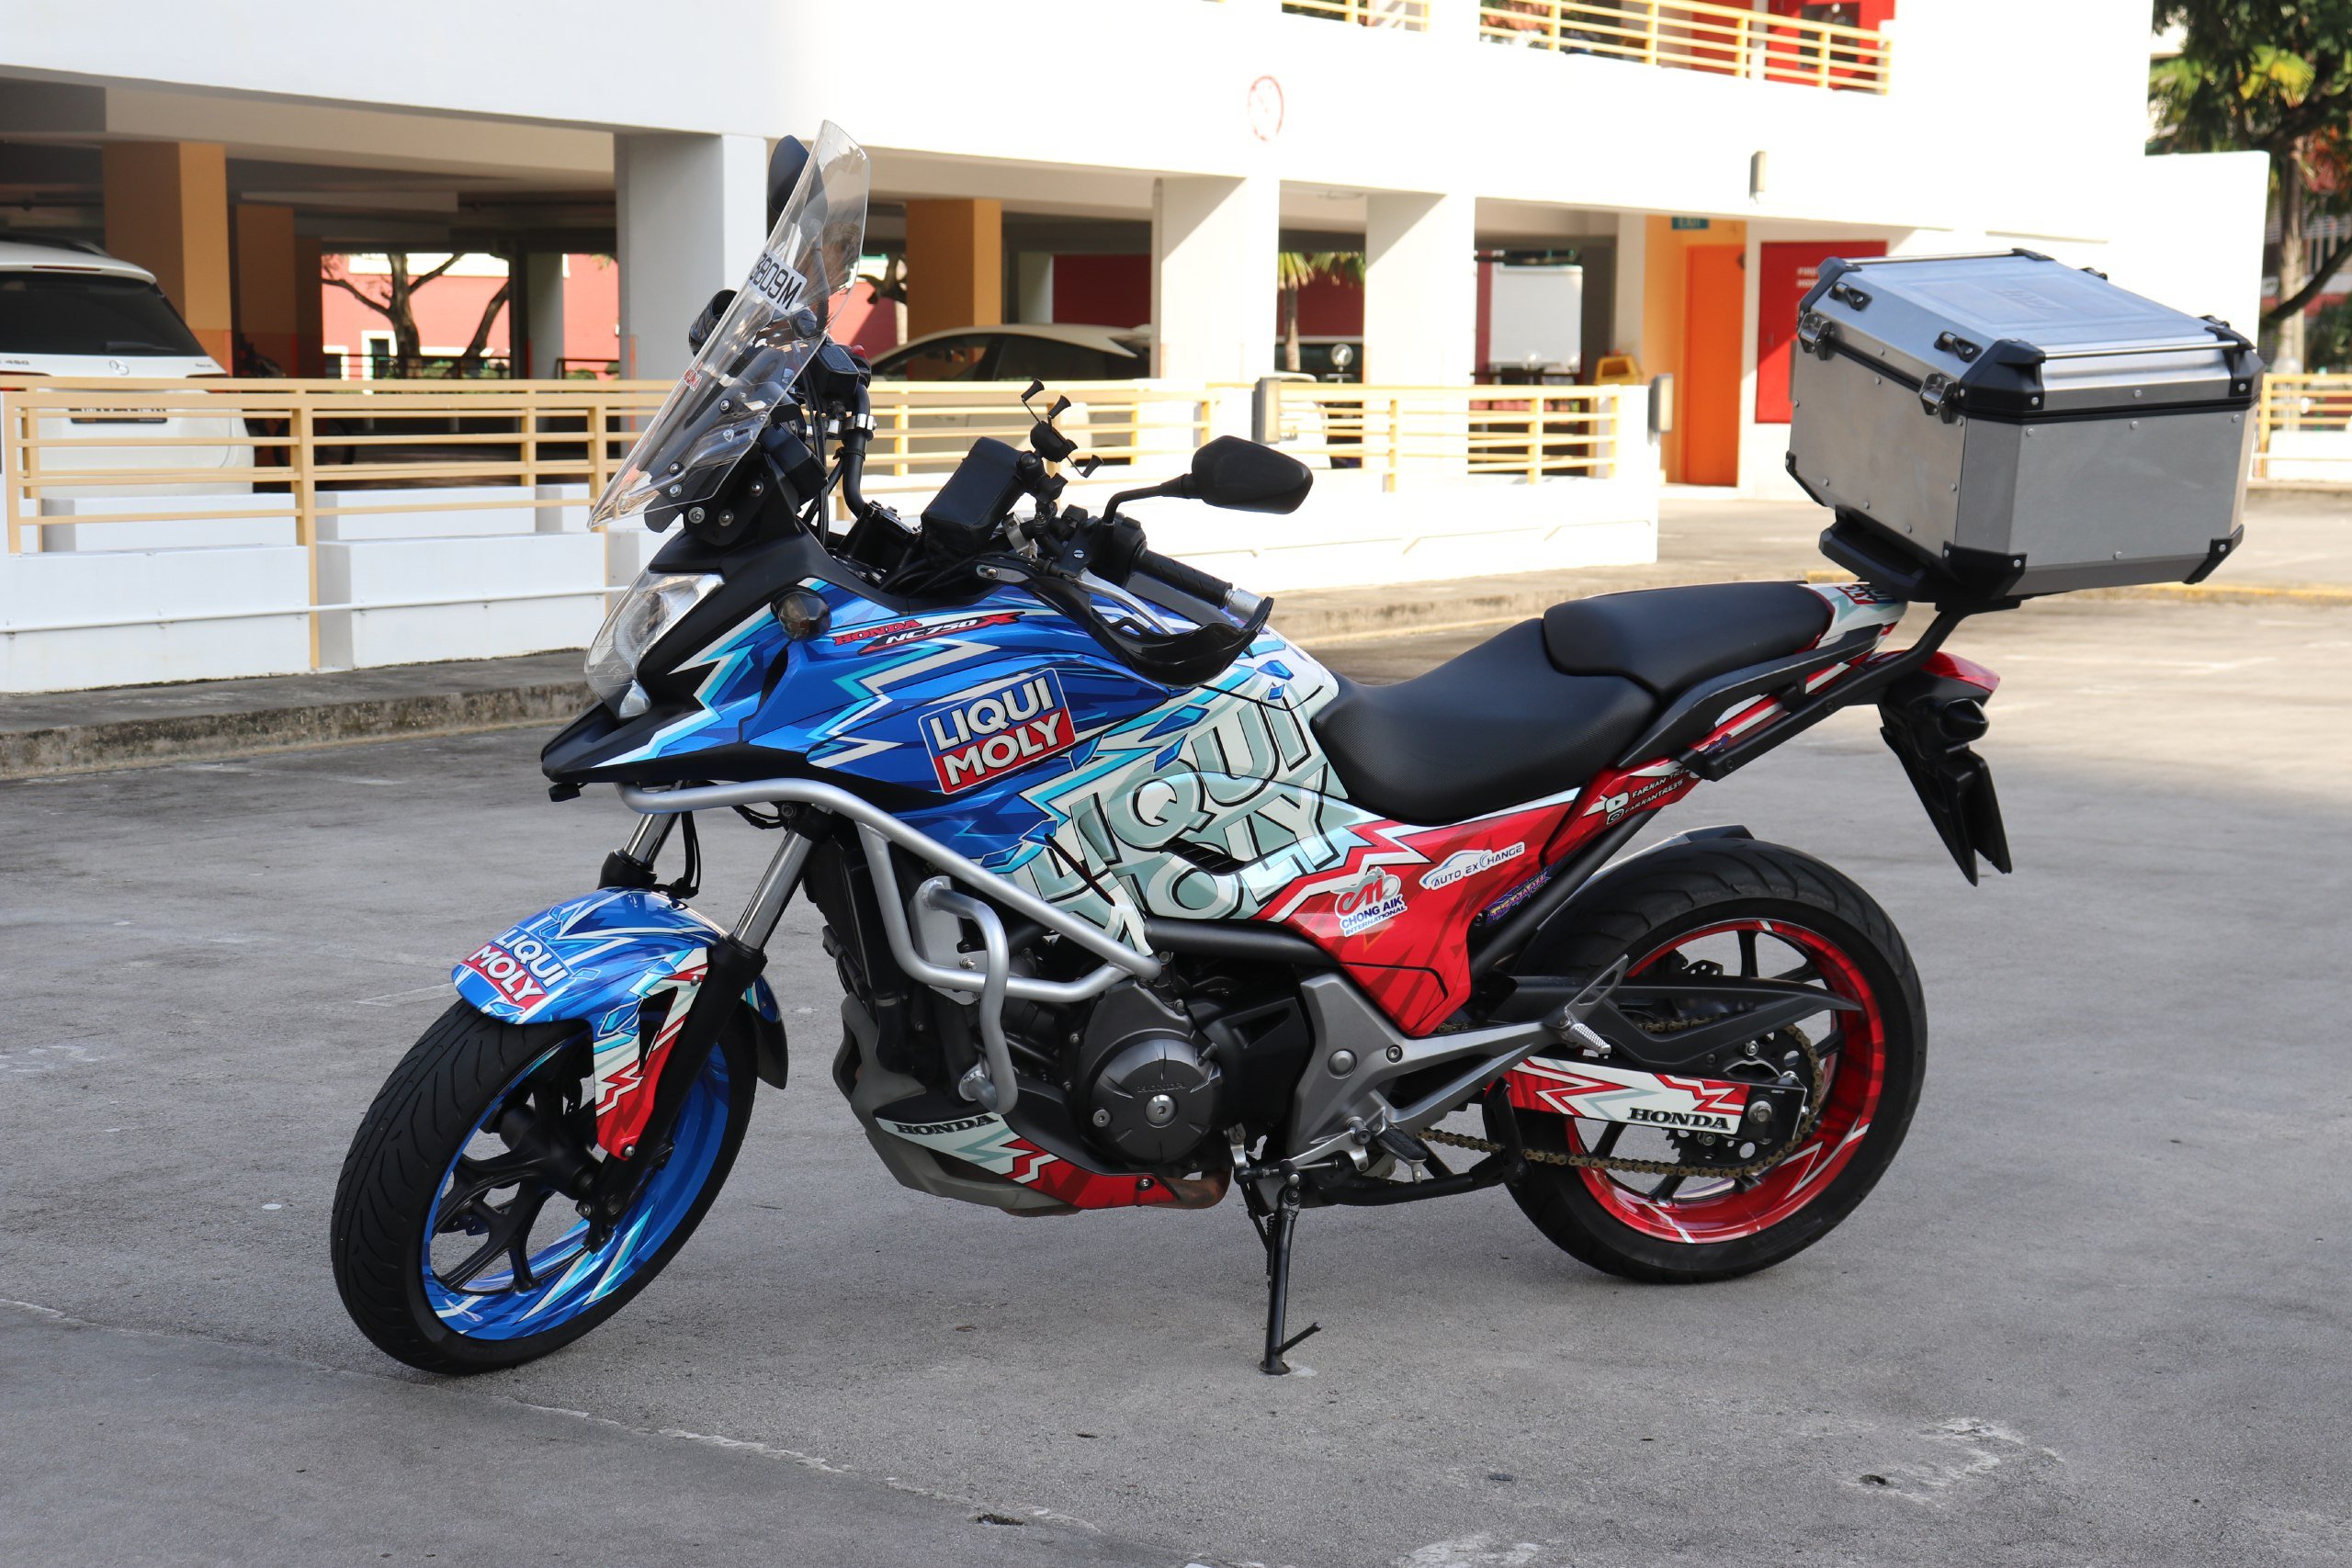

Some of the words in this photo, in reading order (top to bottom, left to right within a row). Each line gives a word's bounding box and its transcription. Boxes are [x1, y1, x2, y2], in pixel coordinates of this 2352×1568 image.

[833, 619, 922, 646] HONDA
[929, 676, 1056, 752] LIQUI
[942, 711, 1063, 786] MOLY
[1433, 870, 1462, 887] AUTO
[1341, 906, 1380, 929] CHONG
[1383, 896, 1403, 912] AIK
[1345, 906, 1407, 935] INTERNATIONAL
[467, 945, 544, 1002] MOLY
[493, 929, 571, 988] LIQUI
[897, 1112, 1000, 1135] HONDA
[1627, 1107, 1731, 1132] HONDA
